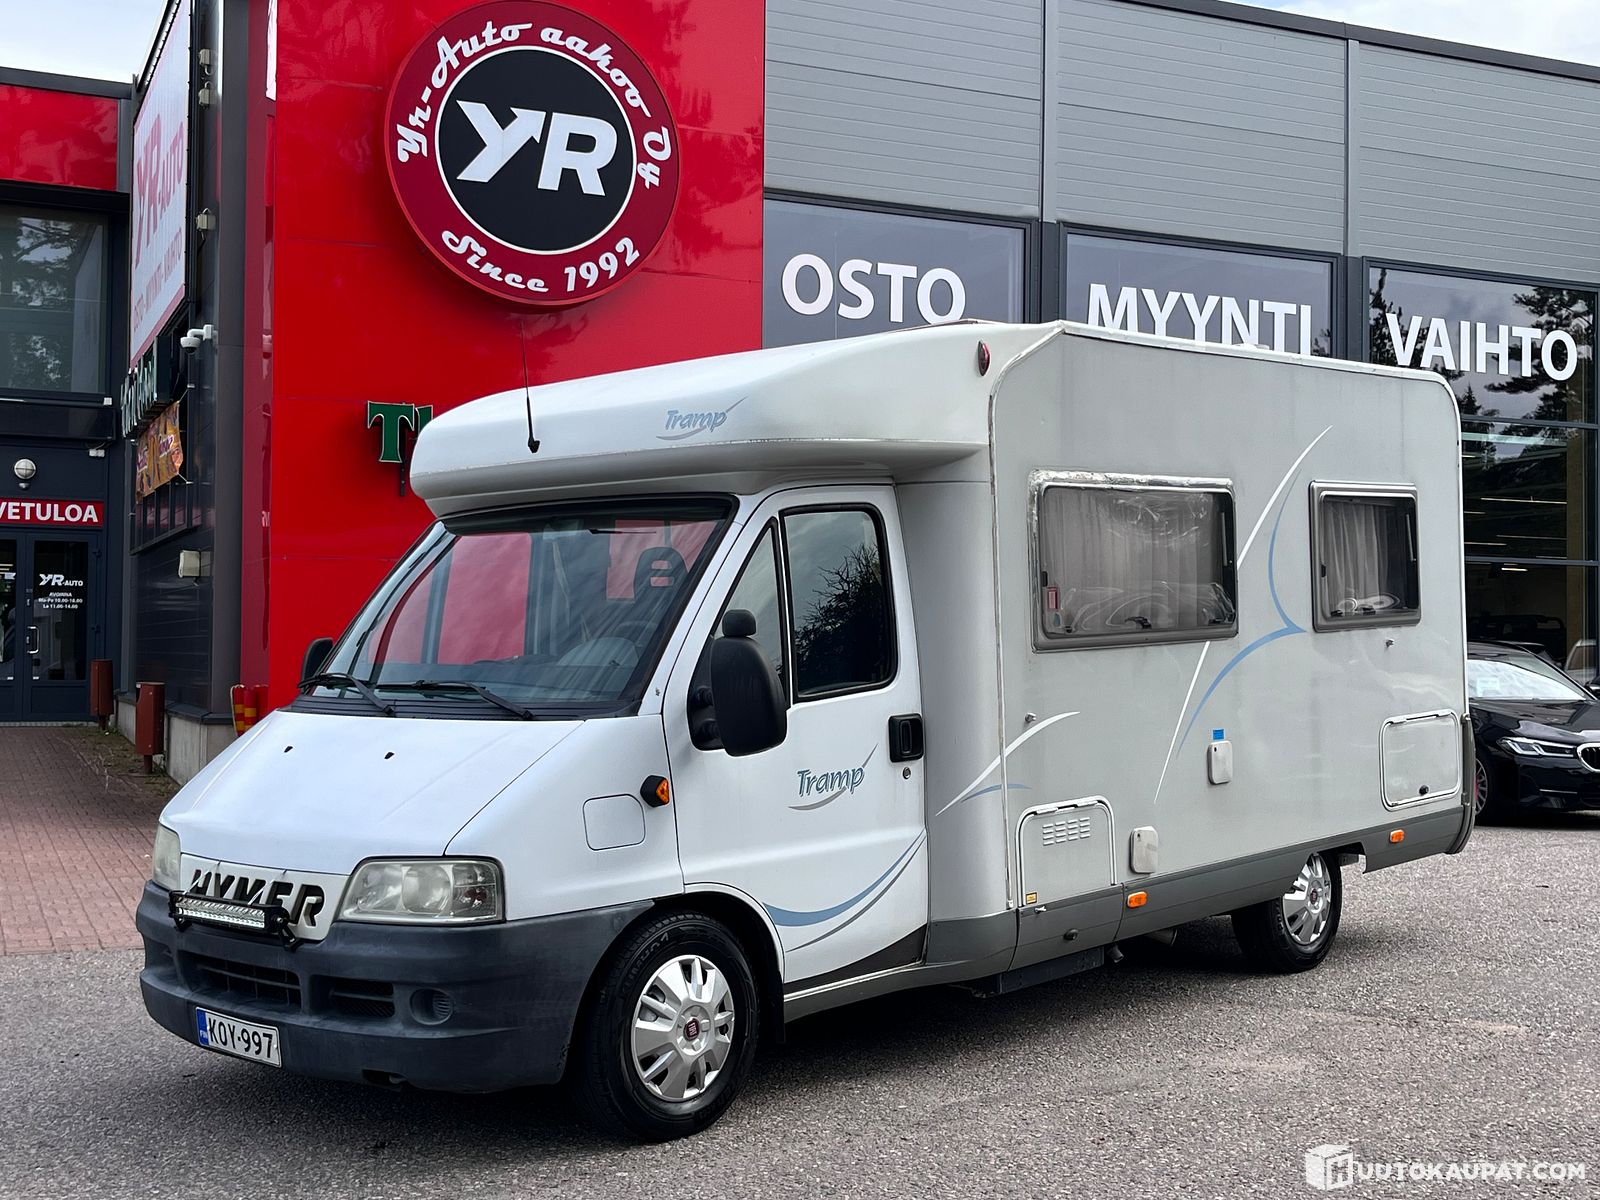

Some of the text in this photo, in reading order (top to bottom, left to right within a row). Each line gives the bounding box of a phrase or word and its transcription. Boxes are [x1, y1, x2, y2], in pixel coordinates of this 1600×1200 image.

[456, 99, 618, 197] YR
[441, 229, 641, 293] Since 1992
[781, 252, 966, 325] OSTO
[1087, 283, 1312, 356] MYYNTI
[1385, 313, 1578, 381] VAIHTO
[664, 408, 728, 433] Tramp
[39, 573, 83, 586] YR-AUTO
[797, 767, 865, 797] Tramp
[208, 1017, 274, 1059] KOY-997
